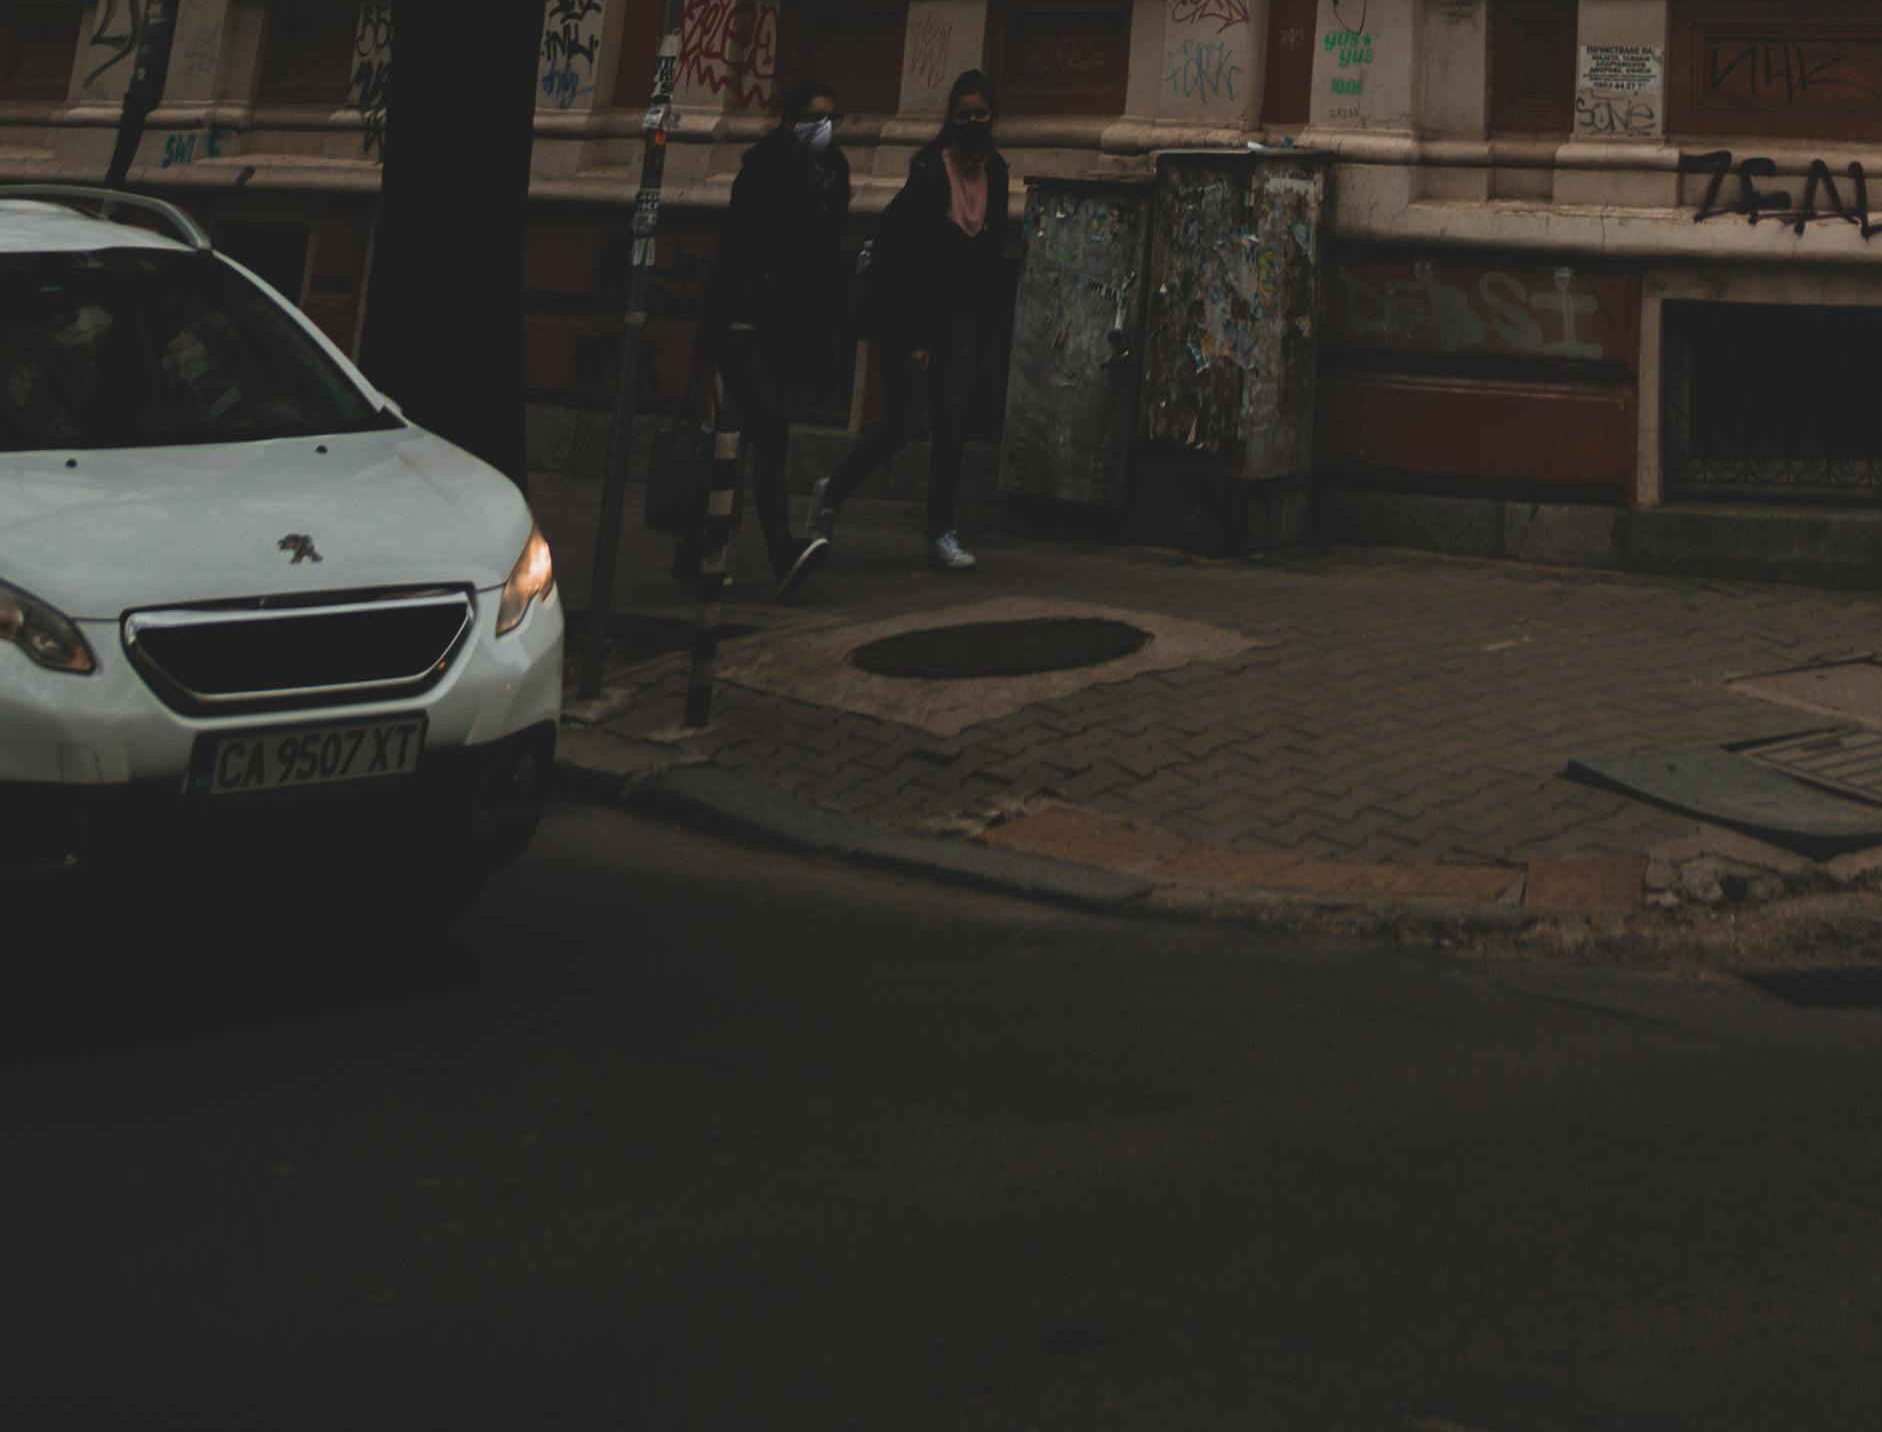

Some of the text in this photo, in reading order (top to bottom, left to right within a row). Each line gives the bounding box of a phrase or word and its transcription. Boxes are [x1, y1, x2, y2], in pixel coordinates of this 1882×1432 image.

[1587, 46, 1640, 55] ПОЧИСТВАНЕ
[218, 723, 418, 788] CA 9507 XT
